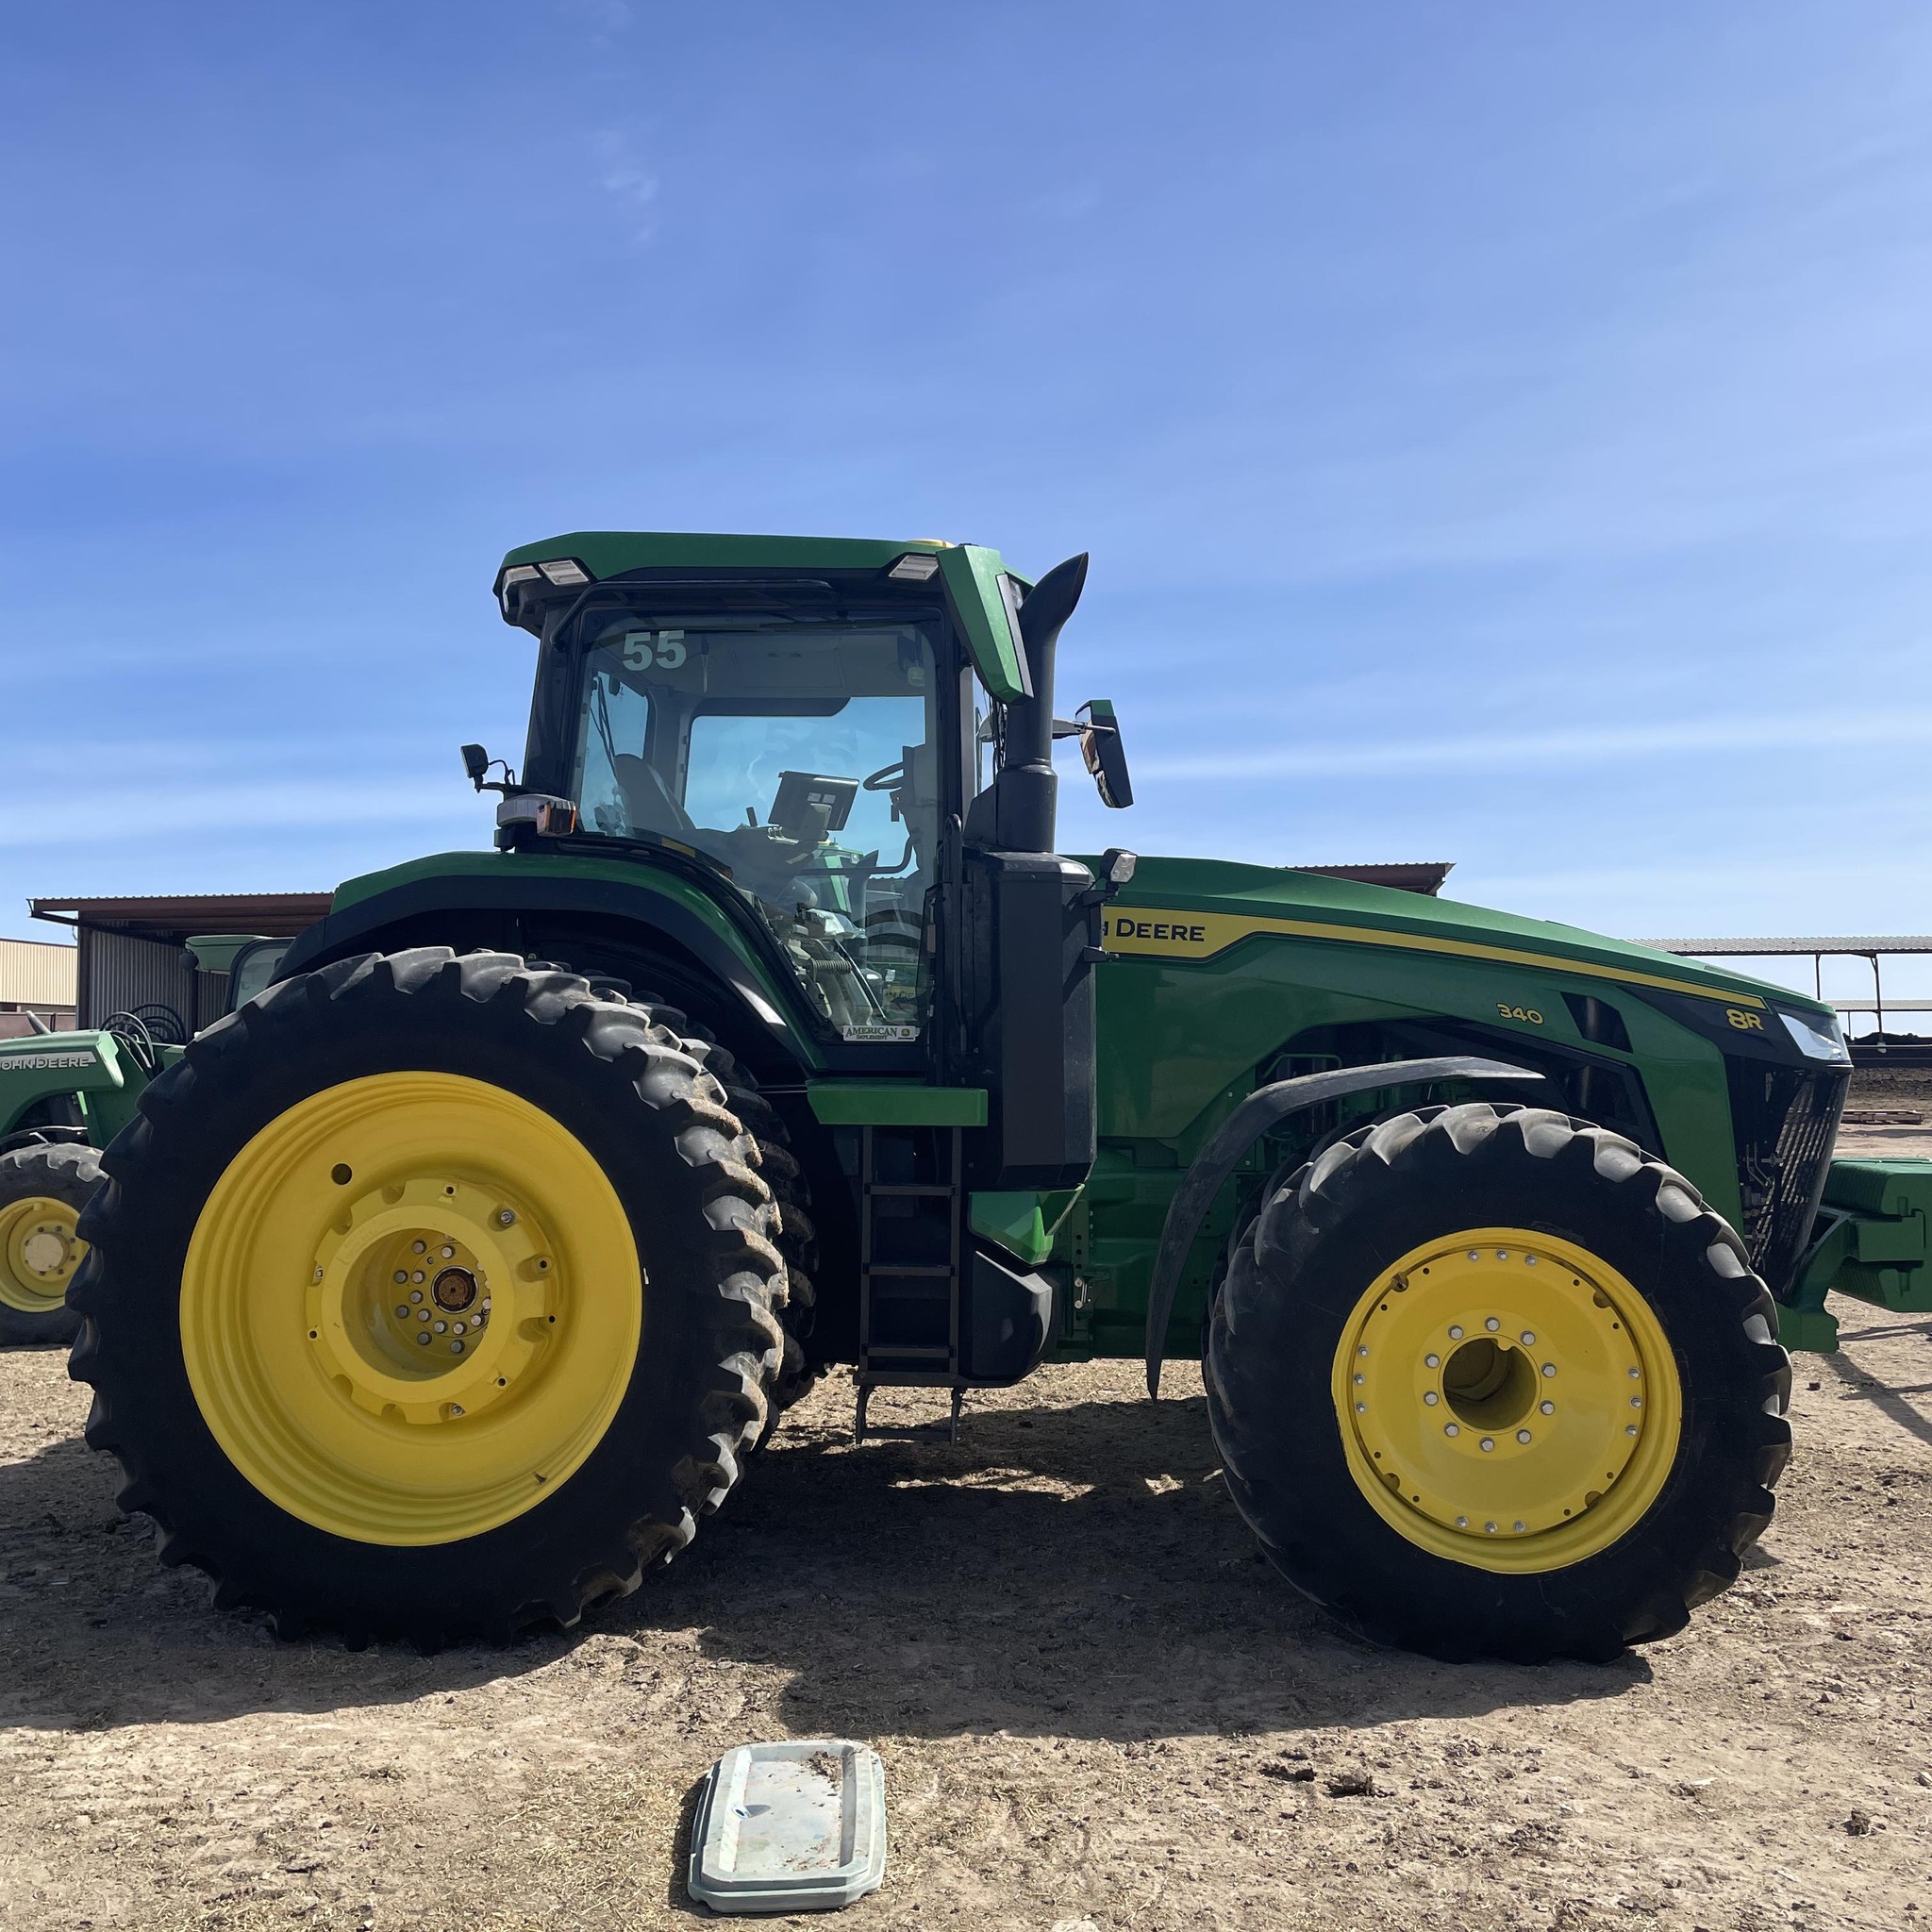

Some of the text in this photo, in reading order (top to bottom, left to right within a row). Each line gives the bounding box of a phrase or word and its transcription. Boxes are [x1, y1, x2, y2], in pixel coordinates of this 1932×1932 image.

[623, 630, 687, 671] 55
[1116, 918, 1206, 941] DEERE
[1496, 1003, 1544, 1025] 340
[1725, 1008, 1764, 1031] 8R
[845, 1026, 898, 1038] AMERICAN
[0, 1057, 90, 1071] OHN DEERE
